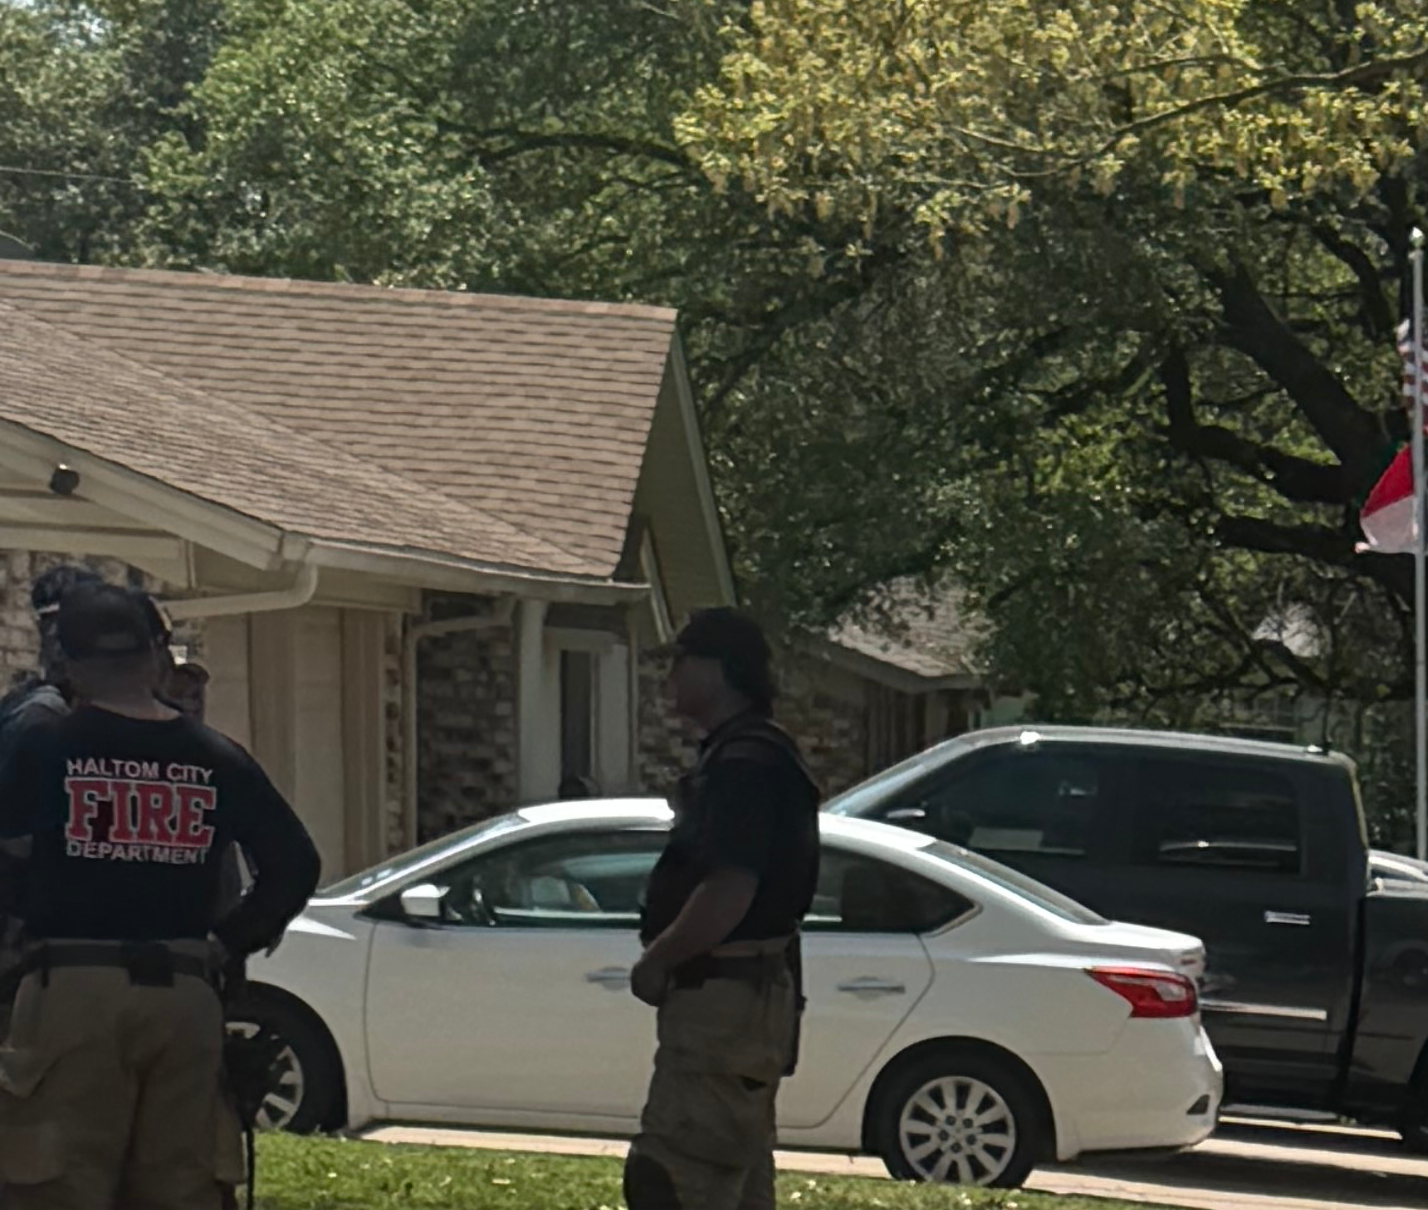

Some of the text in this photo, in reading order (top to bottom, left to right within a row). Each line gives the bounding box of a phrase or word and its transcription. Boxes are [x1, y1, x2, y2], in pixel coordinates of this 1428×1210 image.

[65, 757, 213, 784] HALTOM CITY
[64, 776, 217, 848] FIRE
[65, 839, 211, 865] DEPARTMENT
